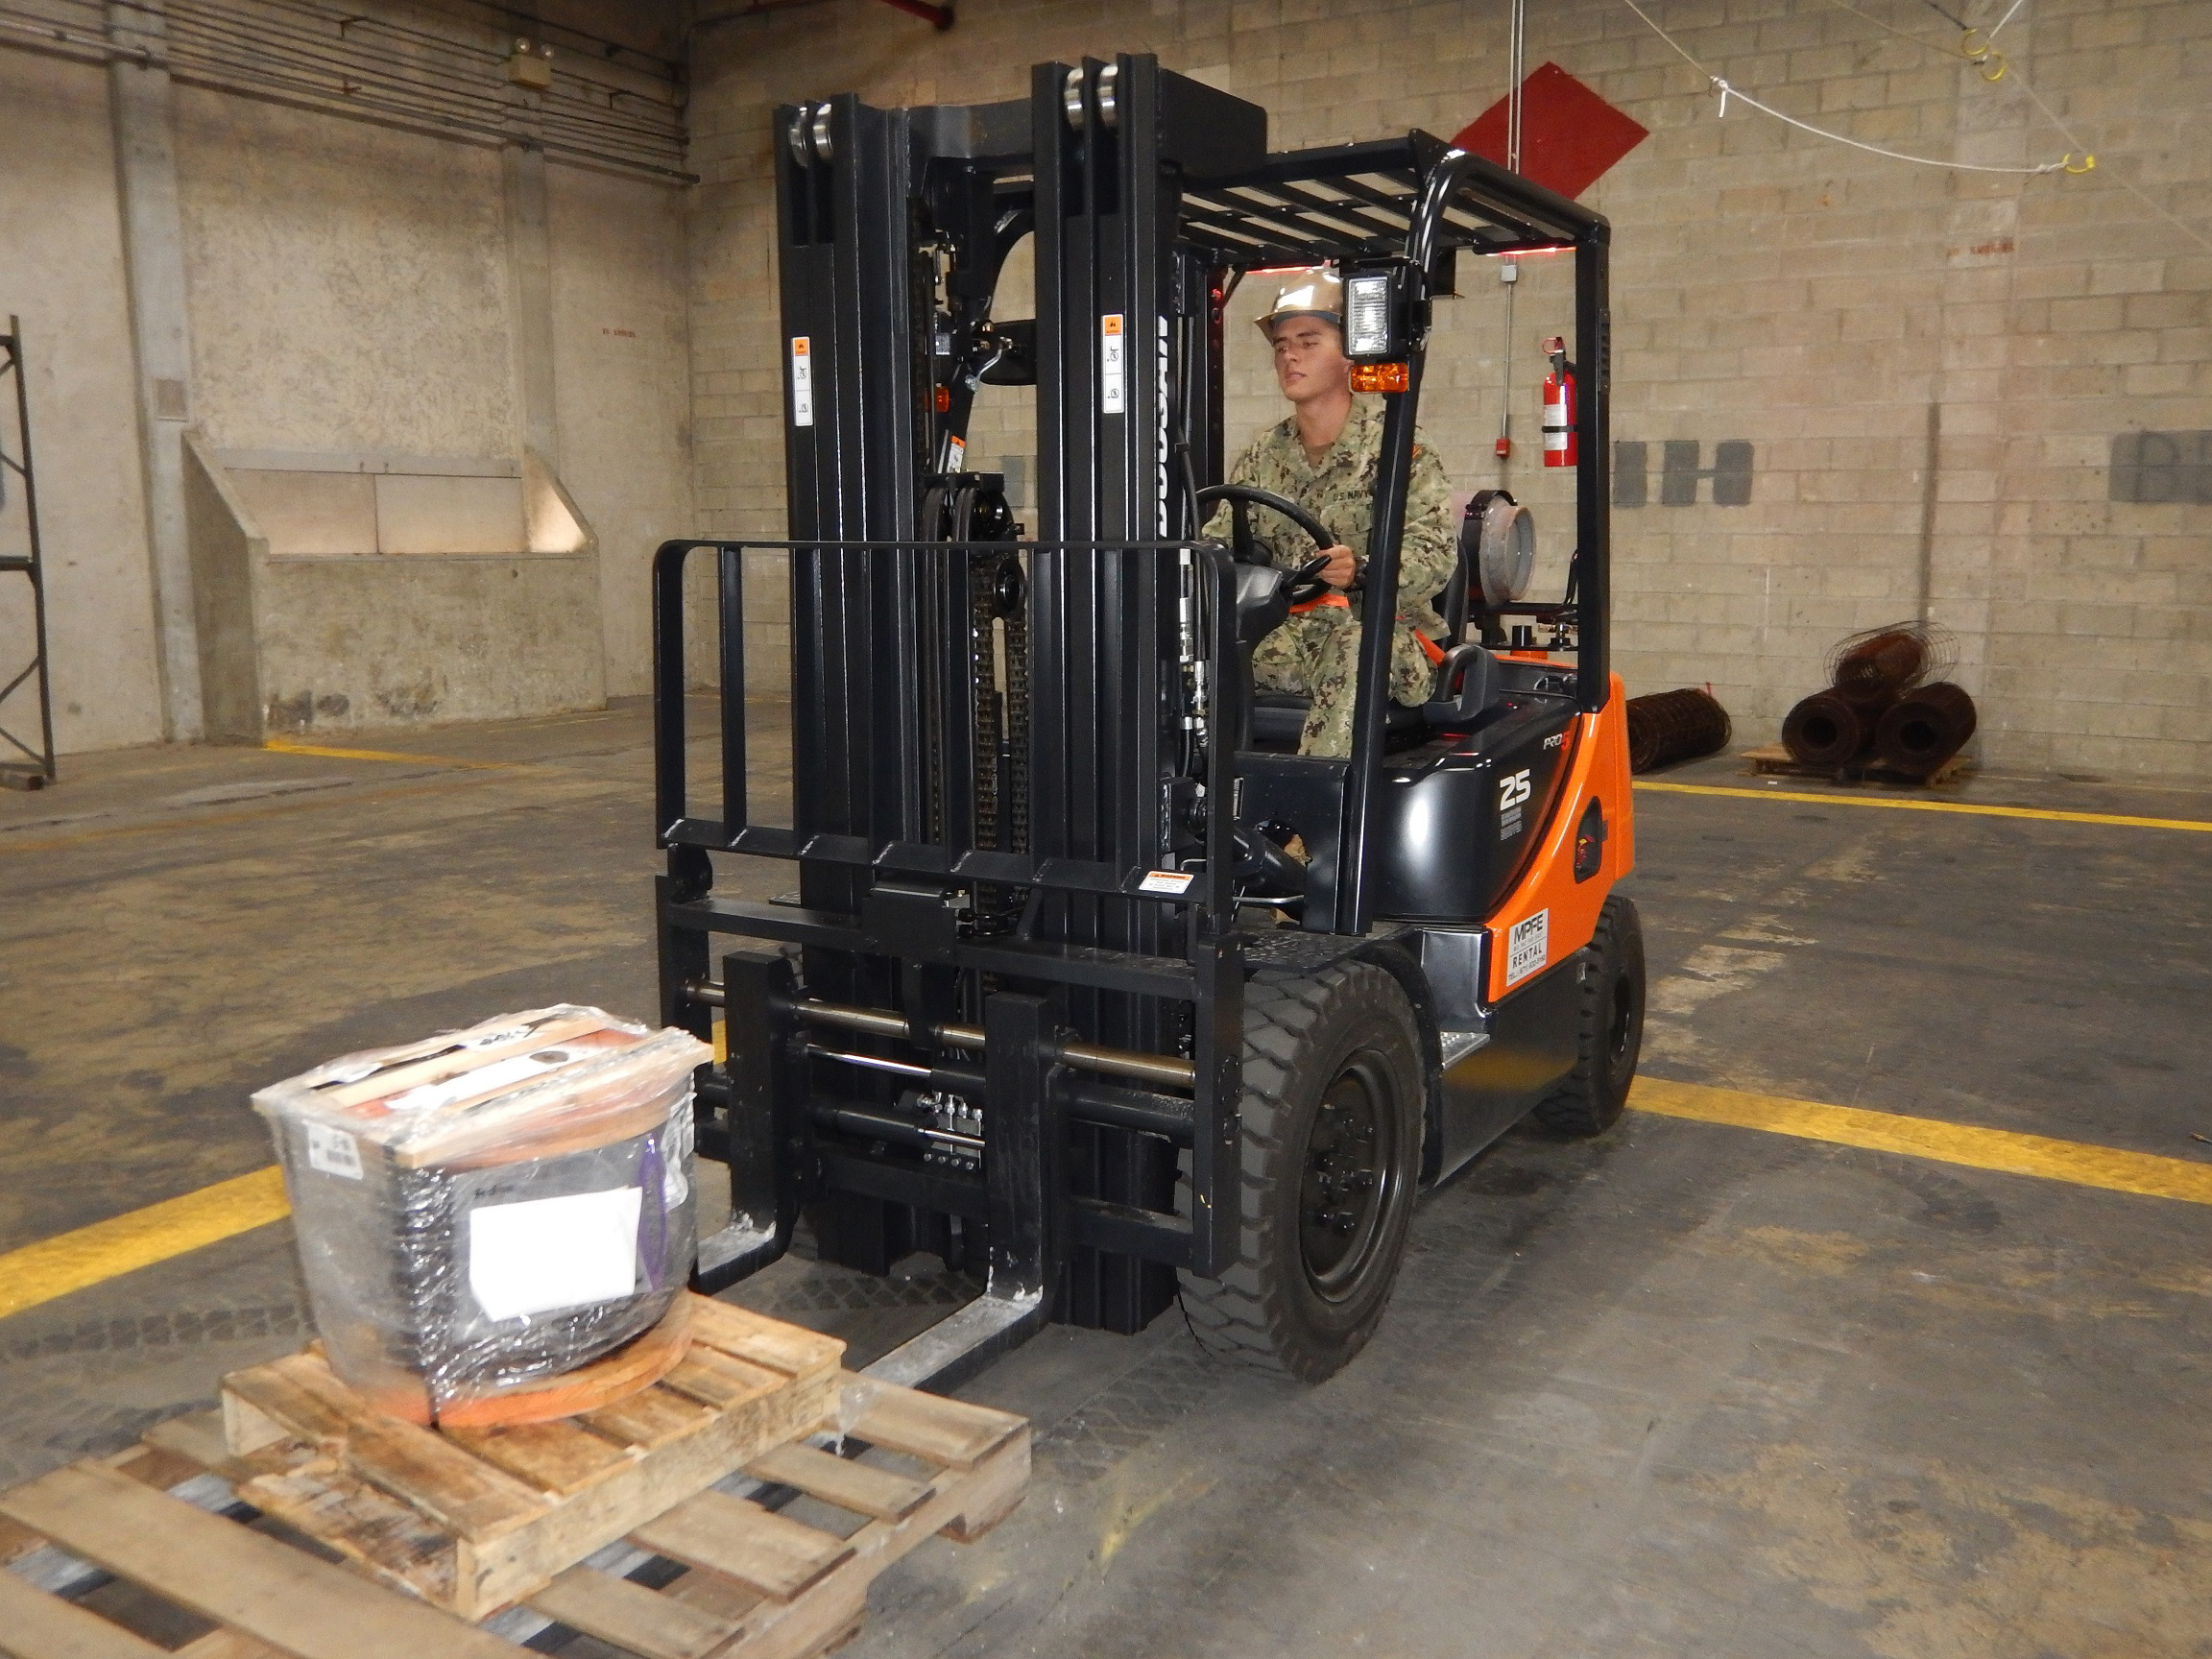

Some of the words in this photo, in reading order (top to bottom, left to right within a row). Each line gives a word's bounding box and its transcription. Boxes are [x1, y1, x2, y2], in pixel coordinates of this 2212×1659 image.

[1500, 768, 1531, 811] 25
[1513, 913, 1544, 945] MPFE
[1512, 942, 1542, 970] RENTAL
